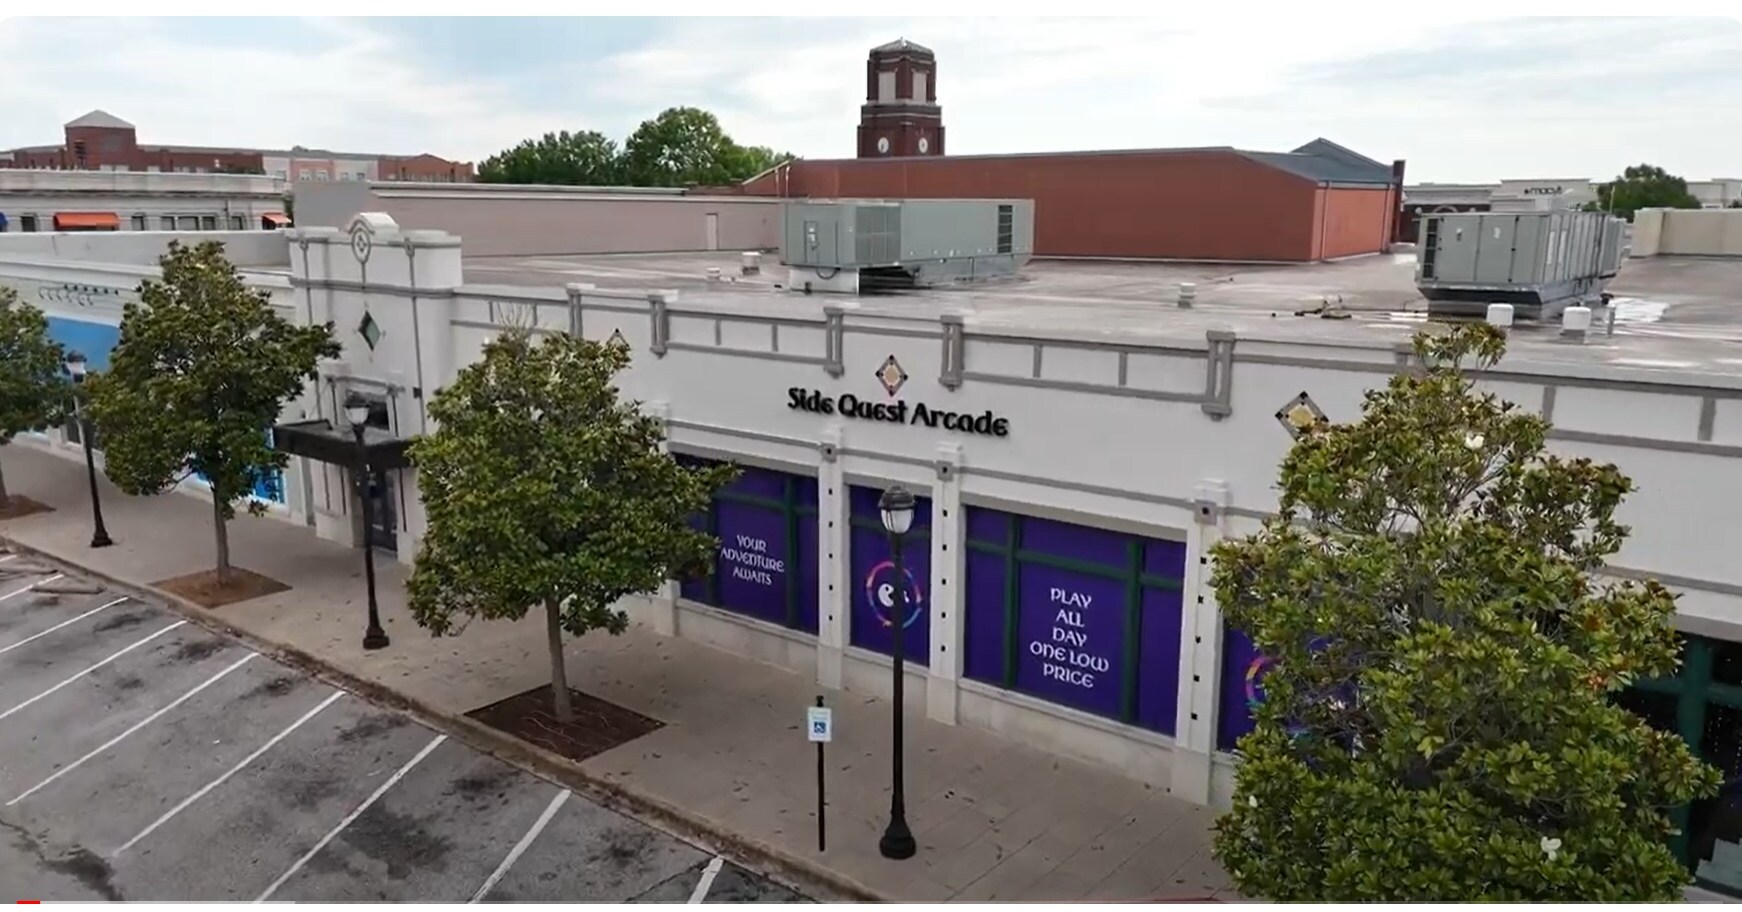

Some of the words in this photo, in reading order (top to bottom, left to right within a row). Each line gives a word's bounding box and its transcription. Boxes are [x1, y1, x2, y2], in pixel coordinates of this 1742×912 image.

[788, 387, 833, 414] Side
[838, 394, 908, 424] Quest
[910, 403, 1009, 437] Arcade
[737, 535, 767, 552] YOUR
[721, 548, 784, 572] ADVENTURE
[733, 567, 772, 585] AWAITS
[1050, 588, 1092, 608] PLAY
[1056, 609, 1085, 627] ALL
[1053, 627, 1087, 647] DAY
[1030, 641, 1066, 661] ONE
[1069, 650, 1109, 672] LOW
[1043, 663, 1094, 688] PRICE
